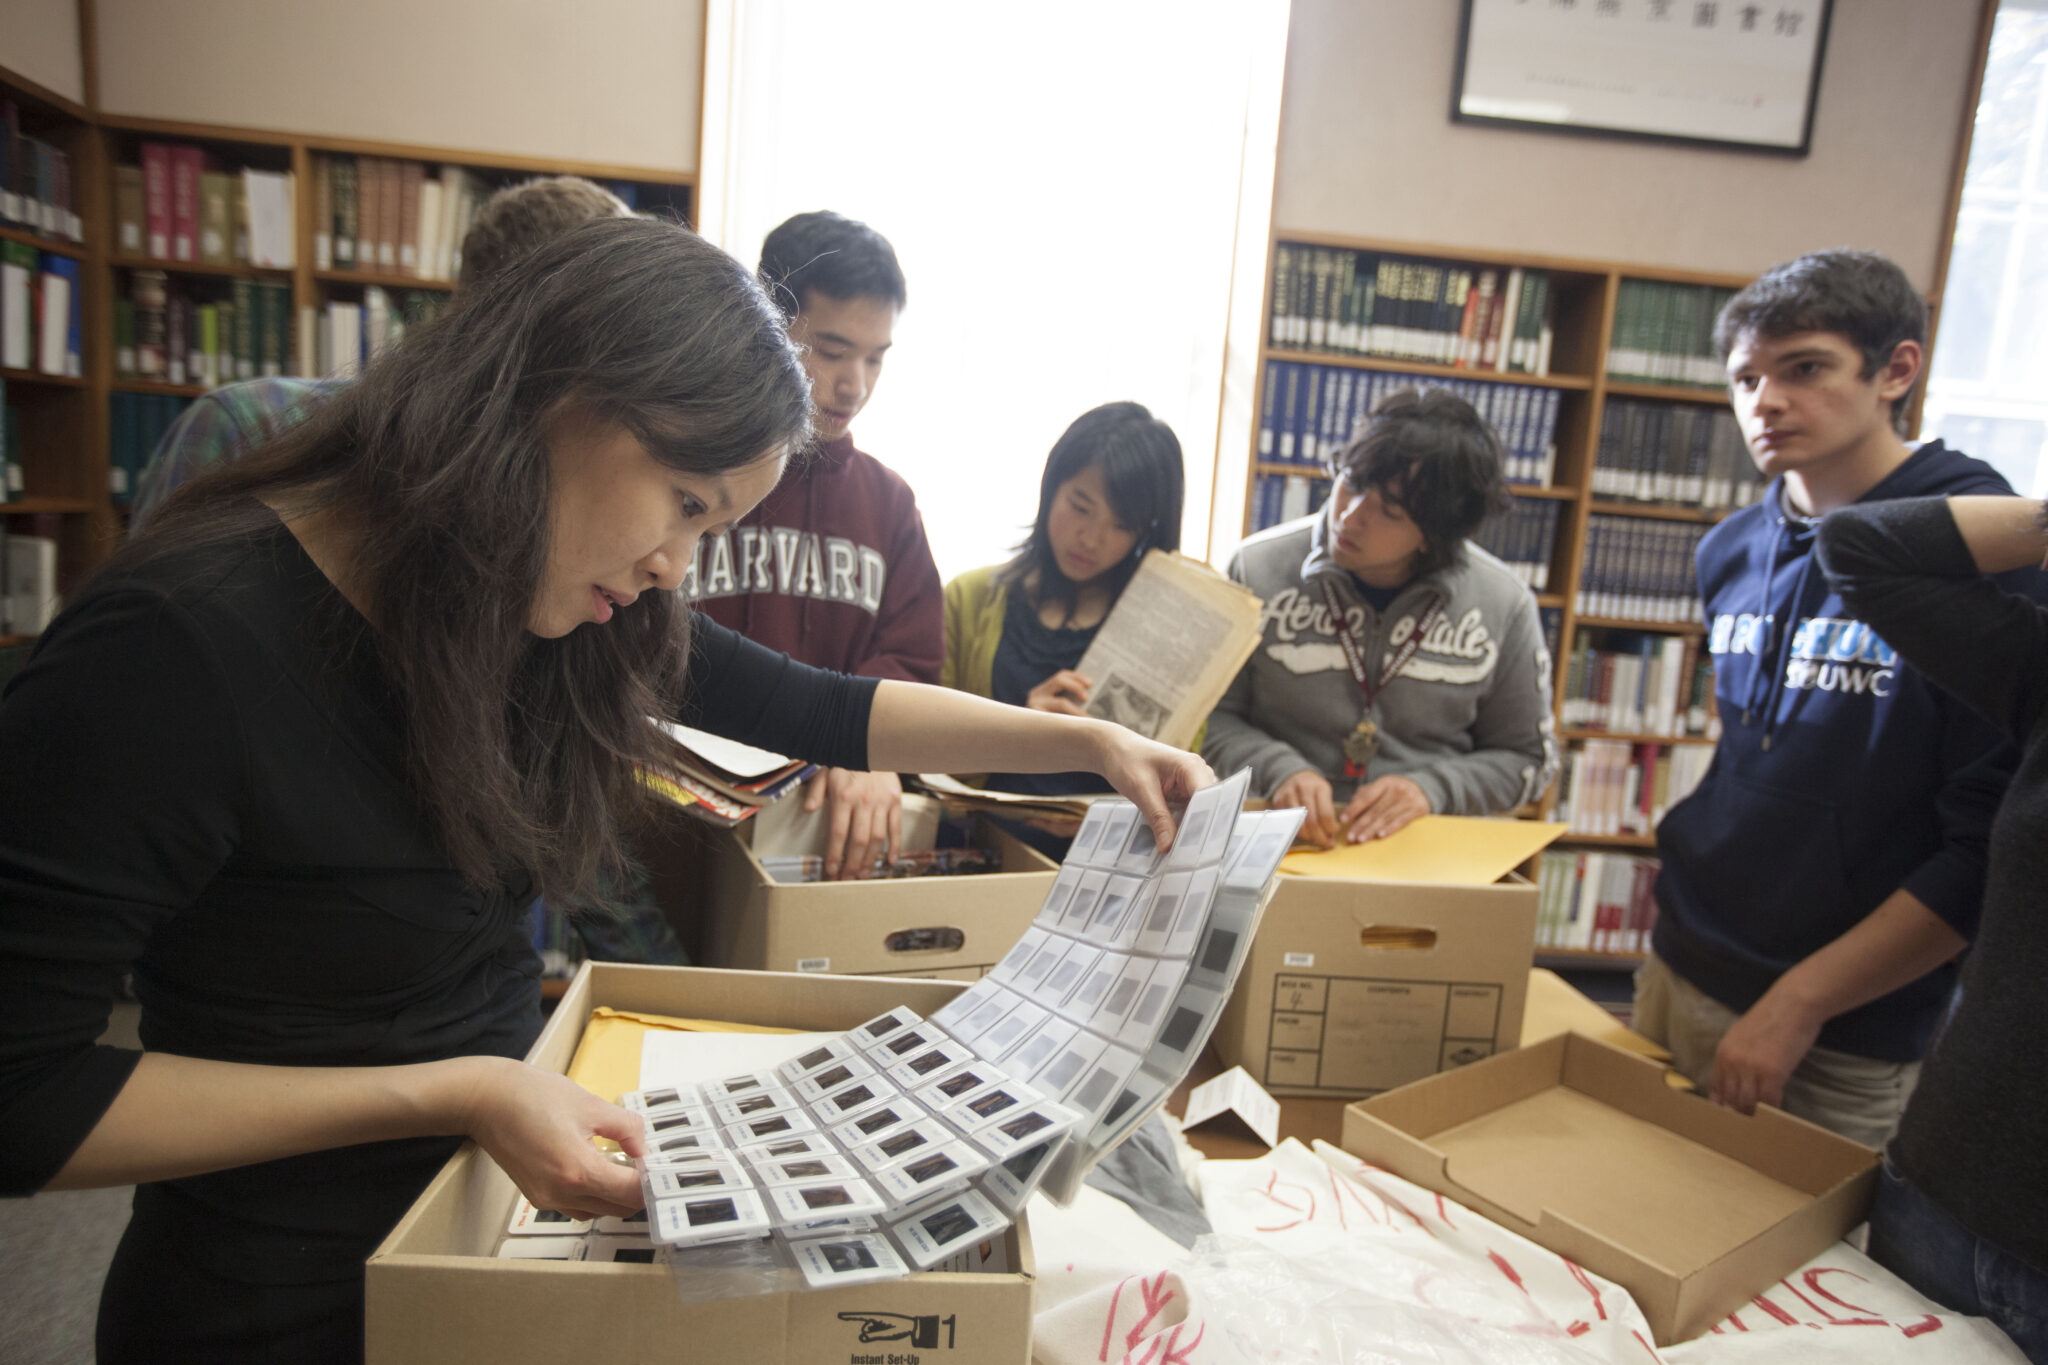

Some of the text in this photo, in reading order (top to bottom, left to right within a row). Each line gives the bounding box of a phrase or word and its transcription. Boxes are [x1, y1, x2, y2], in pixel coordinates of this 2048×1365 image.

[942, 1314, 956, 1349] 1
[851, 1353, 920, 1365] Instant Set-Up
